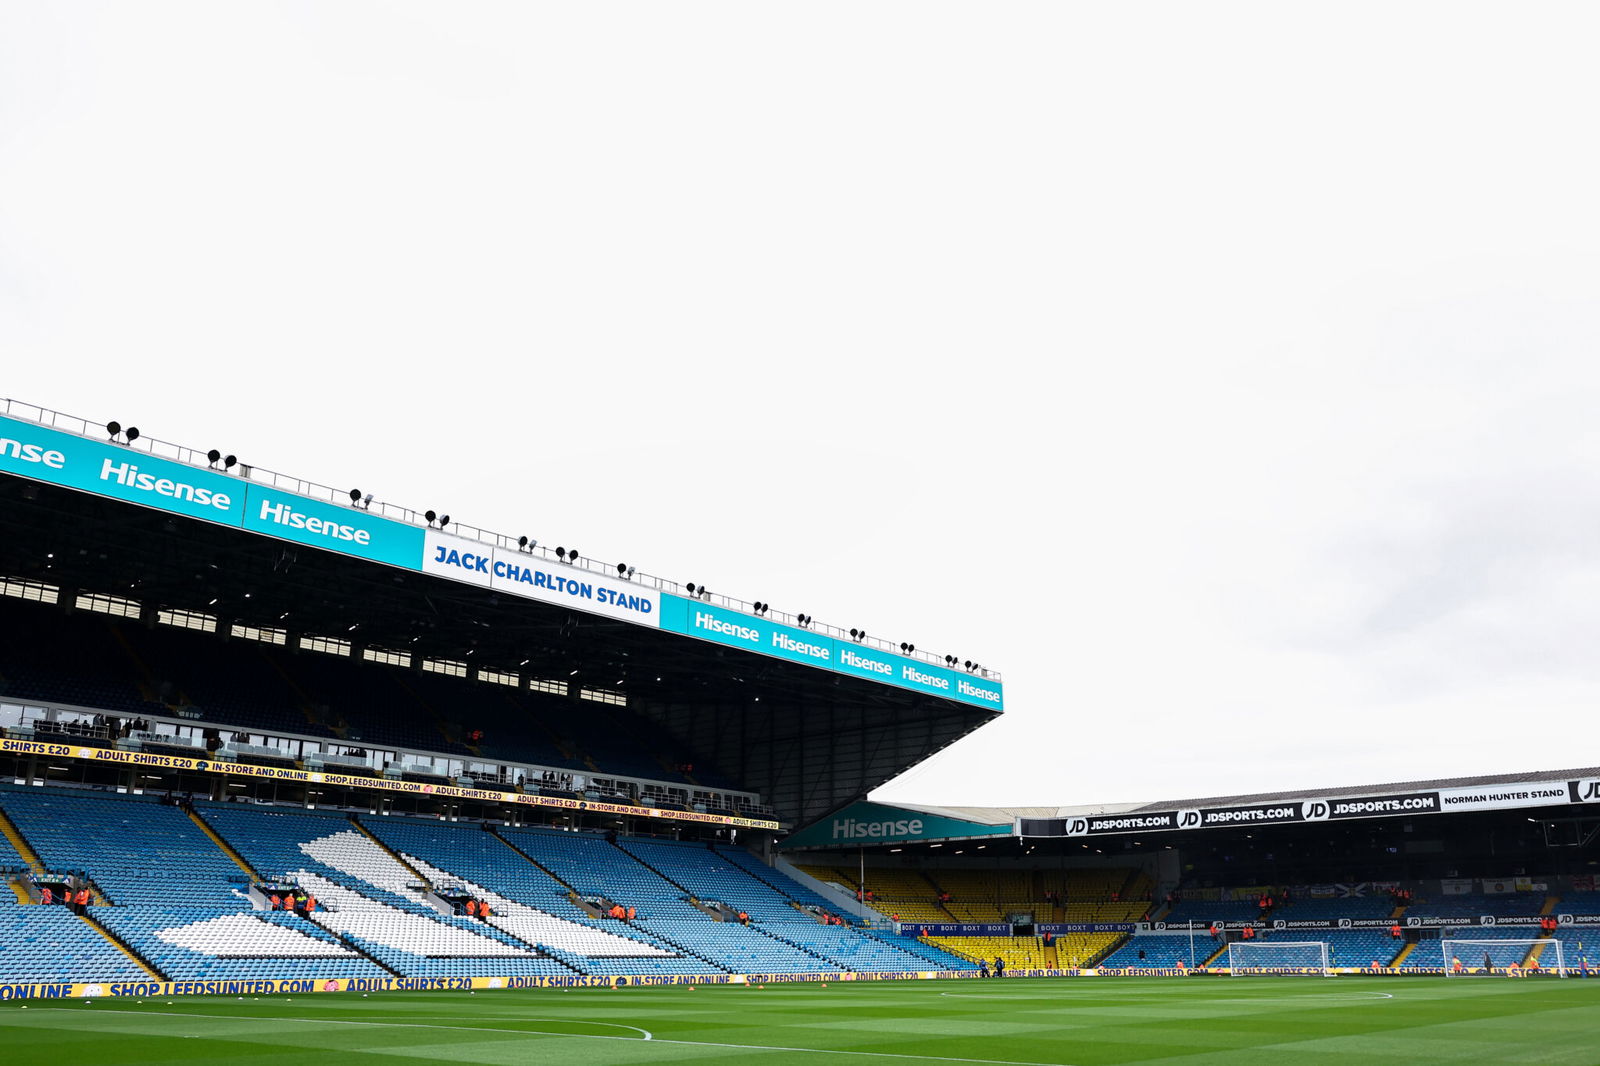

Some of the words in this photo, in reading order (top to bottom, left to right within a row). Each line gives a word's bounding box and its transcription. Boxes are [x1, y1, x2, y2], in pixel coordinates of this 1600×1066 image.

[100, 458, 231, 510] Hisense
[259, 499, 371, 545] Hisense
[434, 545, 489, 574] JACK
[493, 561, 593, 599] CHARLTON
[596, 587, 652, 613] STAND
[695, 611, 760, 642] Hisense
[772, 631, 830, 660] Hisense
[840, 649, 893, 676] Hisense
[902, 665, 949, 690] Hisense
[957, 680, 1000, 702] Hisense
[3, 740, 46, 753] SHIRTS
[48, 745, 70, 755] £20
[95, 750, 132, 762] ADULT
[133, 754, 171, 766] SHIRTS
[172, 757, 192, 768] £20
[212, 762, 254, 775] IN-STORE
[255, 766, 275, 777] AND
[276, 768, 308, 780] ONLINE
[325, 774, 421, 792] SHOP.LEEDSUNITED.COM
[435, 786, 460, 797] ADULT
[461, 788, 487, 799] SHIRTS
[488, 791, 502, 800] £20
[517, 794, 538, 803] ADULT
[540, 797, 564, 807] SHIRTS
[564, 799, 577, 809] £20
[1444, 794, 1487, 804] NORMAN
[1488, 792, 1530, 802] HUNTER
[1531, 789, 1564, 799] STAND
[588, 803, 616, 813] IN-STORE
[617, 805, 629, 814] AND
[629, 806, 650, 816] ONLINE
[1180, 811, 1199, 827] JD
[1205, 807, 1294, 823] JDSPORTS.COM
[1305, 803, 1326, 819] JD
[1333, 797, 1434, 814] JDSPORTS.COM
[732, 818, 749, 826] ADULT
[749, 819, 767, 828] SHIRTS
[832, 818, 924, 839] Hisense
[1068, 819, 1086, 834] JD
[1090, 816, 1170, 831] JDSPORTS.COM
[346, 978, 392, 992] ADULT
[396, 977, 444, 991] SHIRTS
[447, 977, 472, 990] £20
[507, 976, 546, 989] ADULT
[547, 975, 588, 988] SHIRTS
[590, 976, 611, 987] £20
[631, 975, 675, 986] IN-STORE
[677, 974, 698, 985] AND
[698, 974, 730, 985] ONLINE
[0, 984, 73, 999] ONLINE
